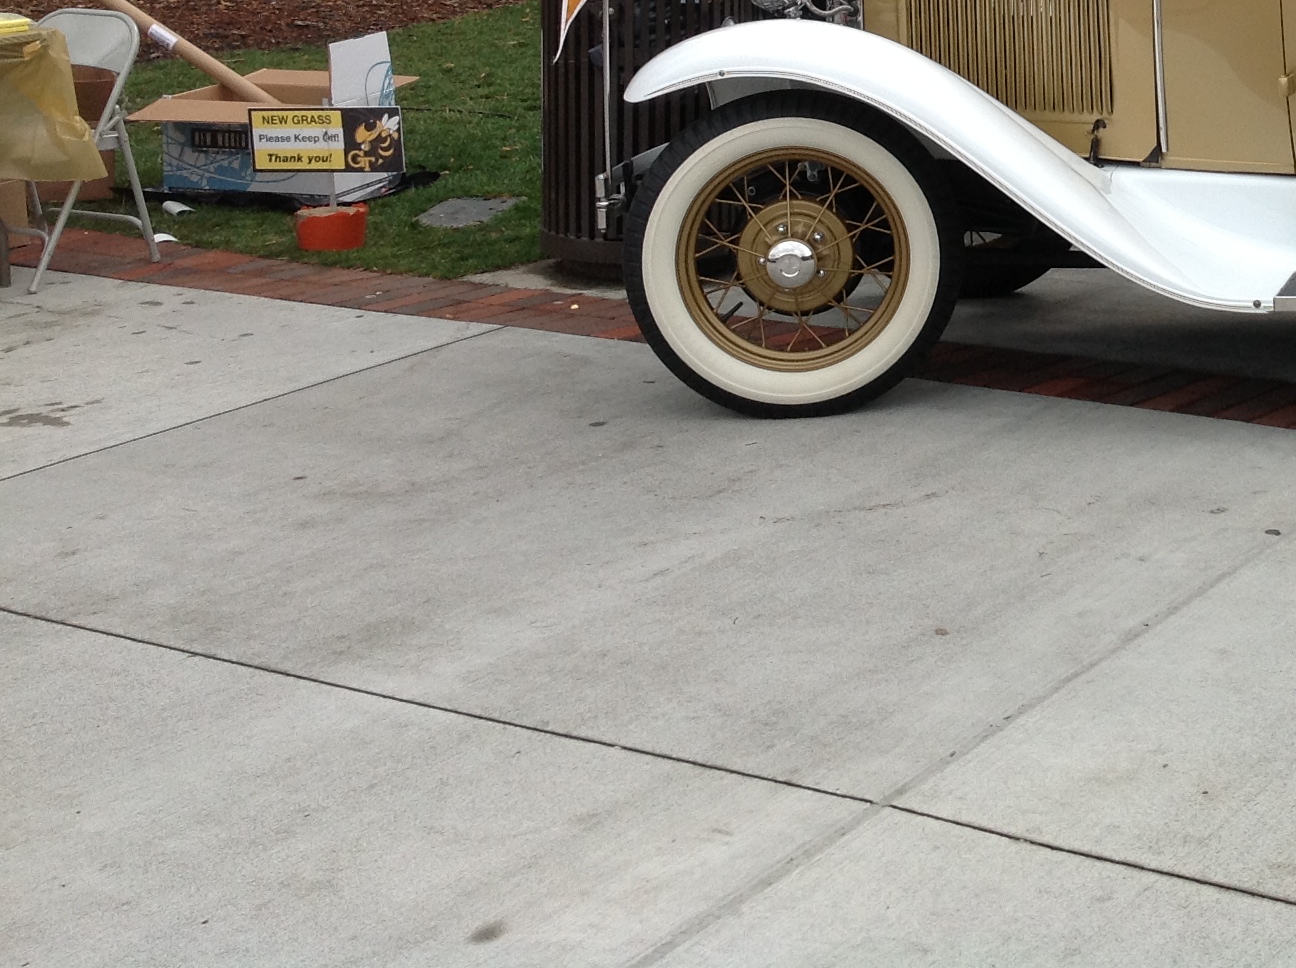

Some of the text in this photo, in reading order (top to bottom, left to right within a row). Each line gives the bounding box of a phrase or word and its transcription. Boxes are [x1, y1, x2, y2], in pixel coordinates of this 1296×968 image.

[261, 114, 332, 125] NEW GRASS
[258, 133, 340, 144] Please Keep Off!
[267, 153, 332, 165] Thank you!
